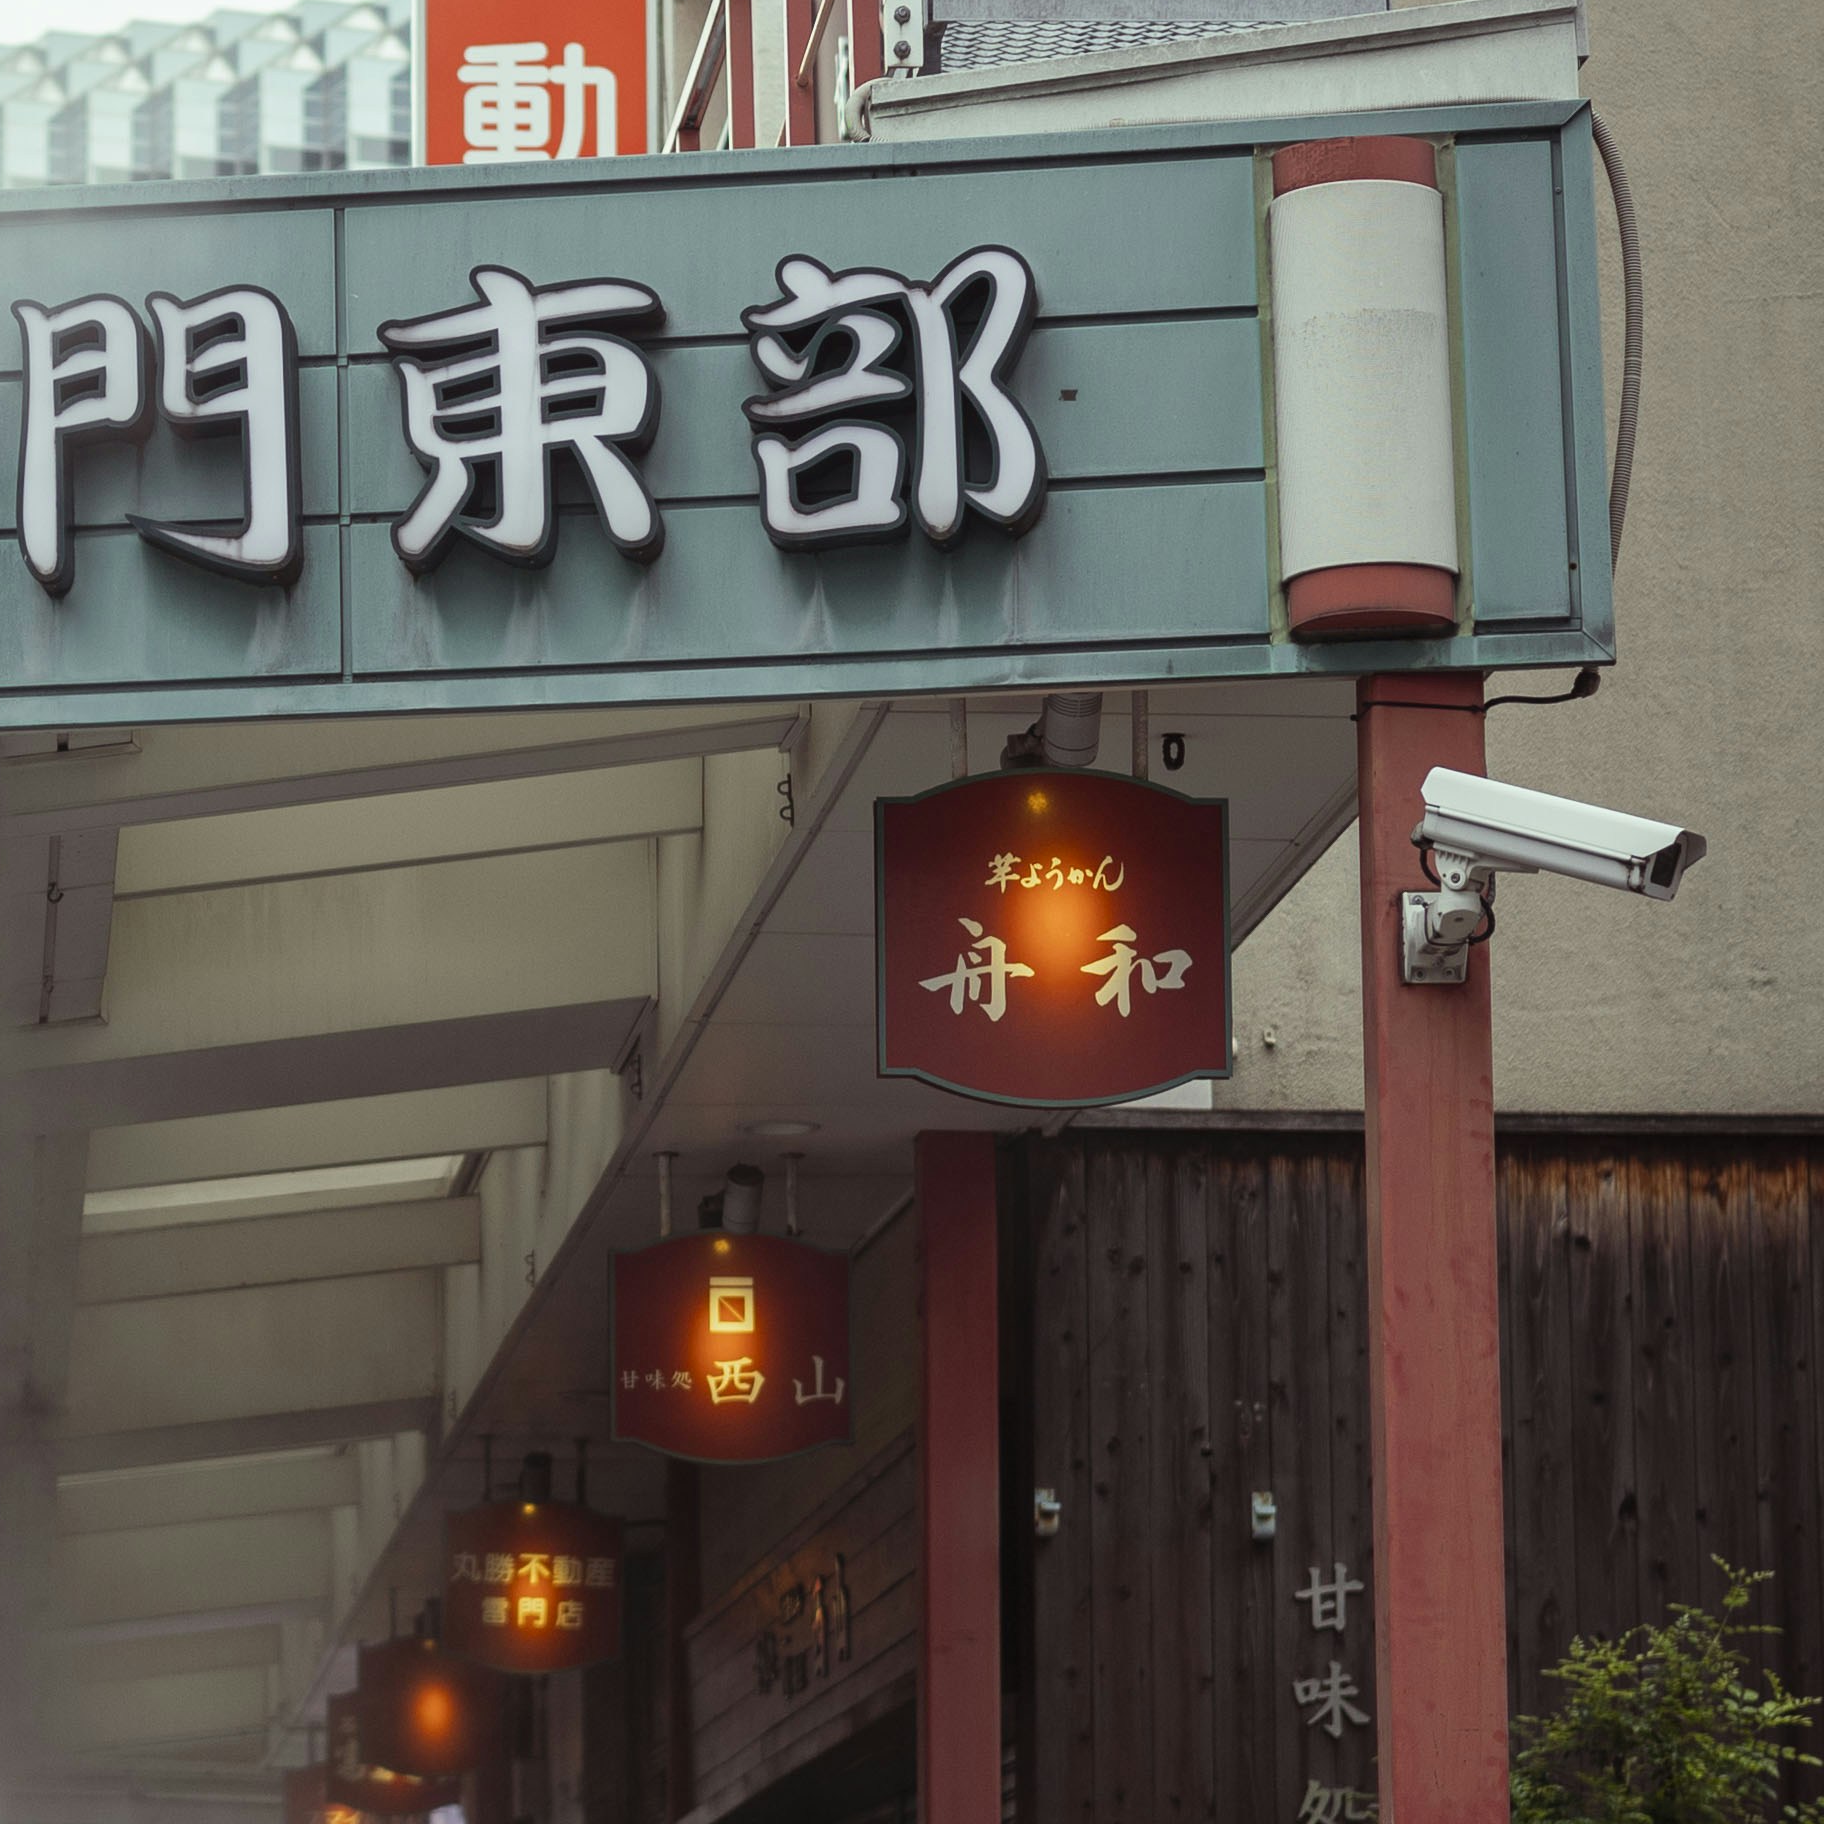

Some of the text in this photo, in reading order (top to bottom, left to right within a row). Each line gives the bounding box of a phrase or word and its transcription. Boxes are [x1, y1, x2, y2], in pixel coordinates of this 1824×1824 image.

[984, 851, 1125, 893] 芋ようかん
[917, 916, 1194, 1023] 舟和
[620, 1355, 846, 1405] 甘味処 西山
[451, 1552, 617, 1587] 丸勝不動産
[482, 1596, 584, 1630] 雷門店
